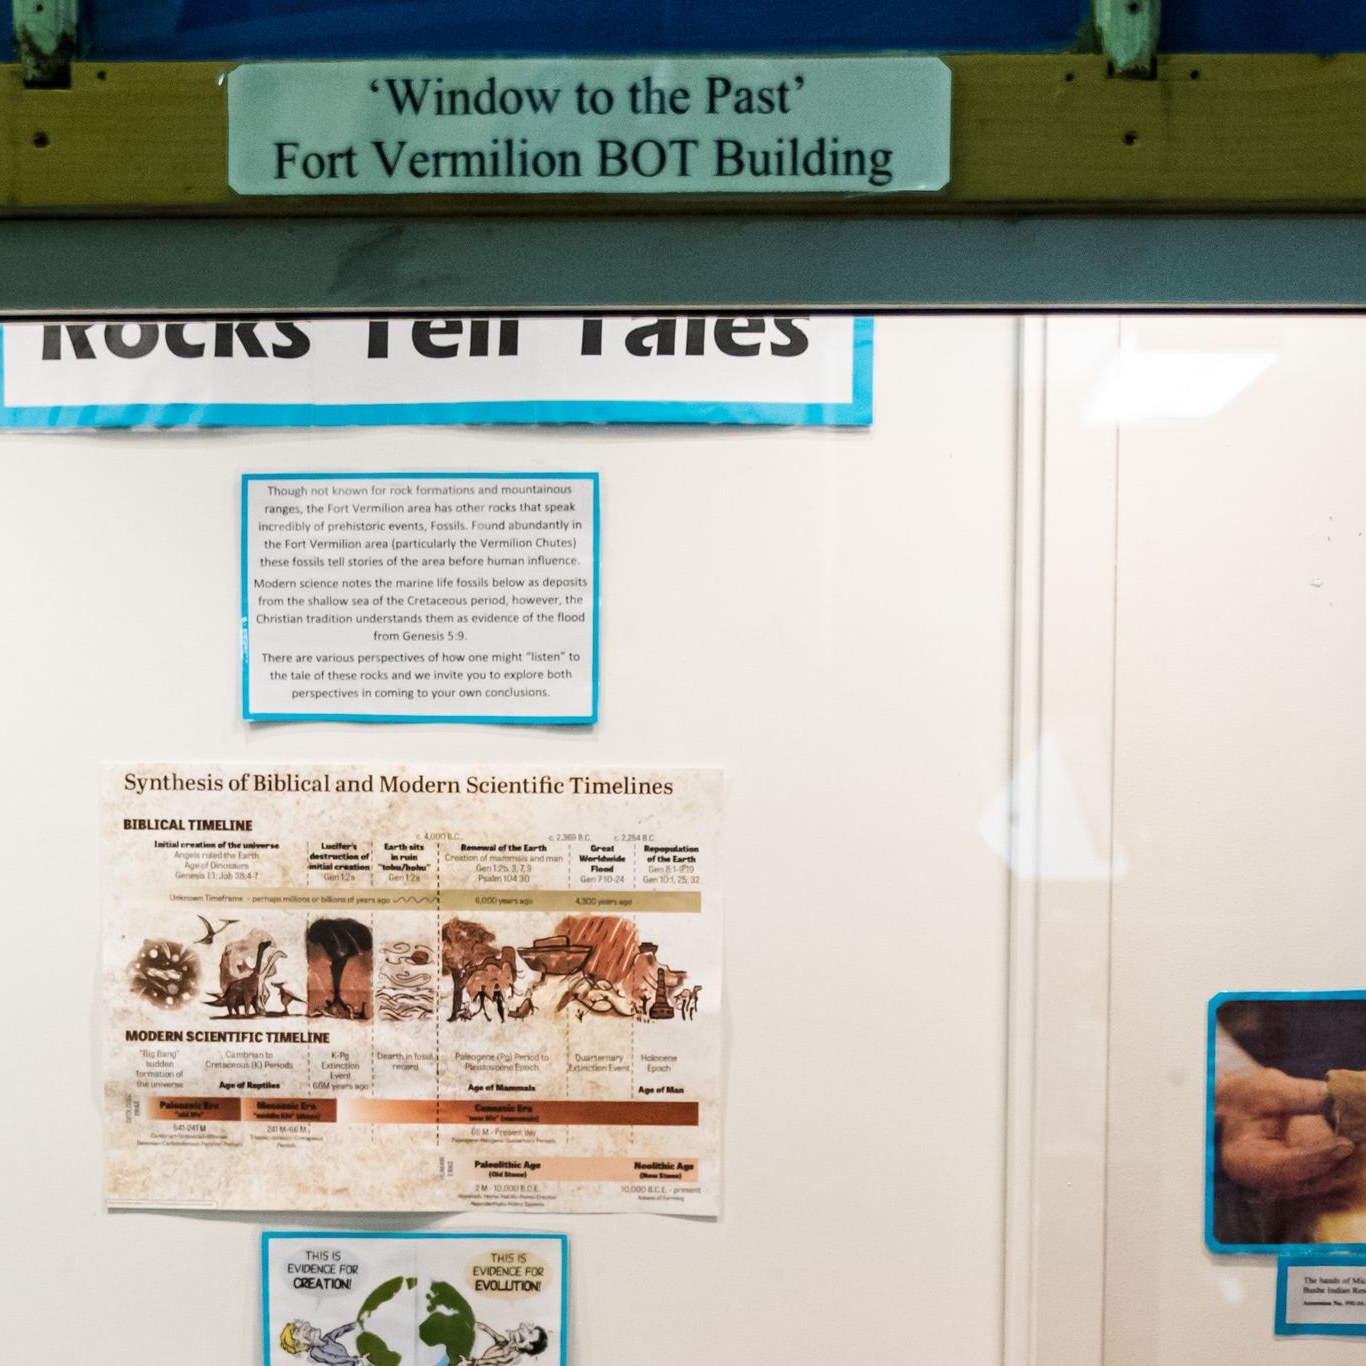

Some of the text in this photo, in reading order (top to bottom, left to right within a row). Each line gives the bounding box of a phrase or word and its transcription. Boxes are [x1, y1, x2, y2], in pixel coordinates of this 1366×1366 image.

[369, 74, 804, 115] ‘Window to the Past’
[273, 136, 893, 186] Fort Vermilion BOT Building
[264, 501, 575, 516] ranges, the Fort Vermilion area has other rocks that speak
[373, 630, 467, 641] from Genesis 5:9.
[124, 772, 673, 794] Synthesis of Biblical and Modern Scientific Timelines
[123, 818, 252, 831] BIBLICAL TIMELINE
[125, 1030, 330, 1043] MODERN SCIENTIFIC TIMELINE
[305, 1250, 341, 1261] THIS IS
[490, 1252, 526, 1263] THIS IS
[287, 1263, 358, 1274] EVIDENCE FOR
[472, 1265, 544, 1276] EVIDENCE FOR
[293, 1276, 351, 1289] CREATION!
[474, 1279, 541, 1291] EVOLUTION!
